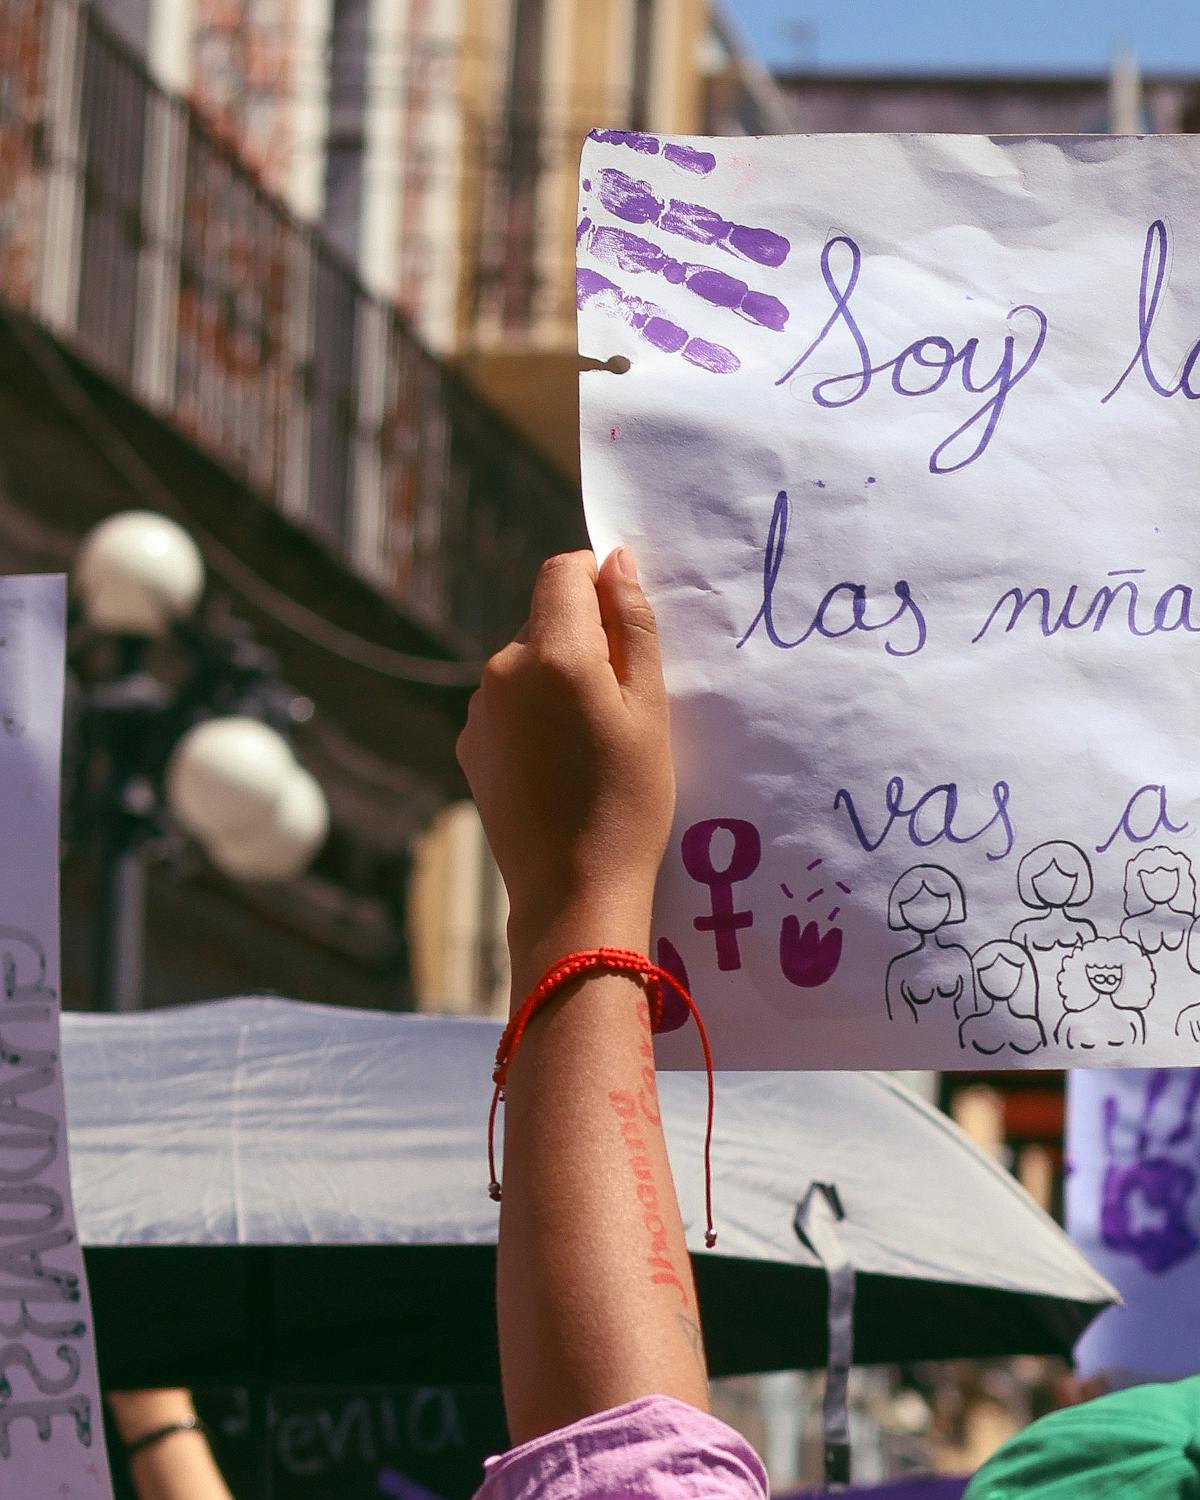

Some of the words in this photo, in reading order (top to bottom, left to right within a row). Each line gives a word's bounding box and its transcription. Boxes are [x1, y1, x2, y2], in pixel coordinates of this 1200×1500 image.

[775, 235, 1048, 474] Soy
[736, 490, 926, 656] las
[834, 776, 1015, 860] vas
[1096, 784, 1188, 852] a
